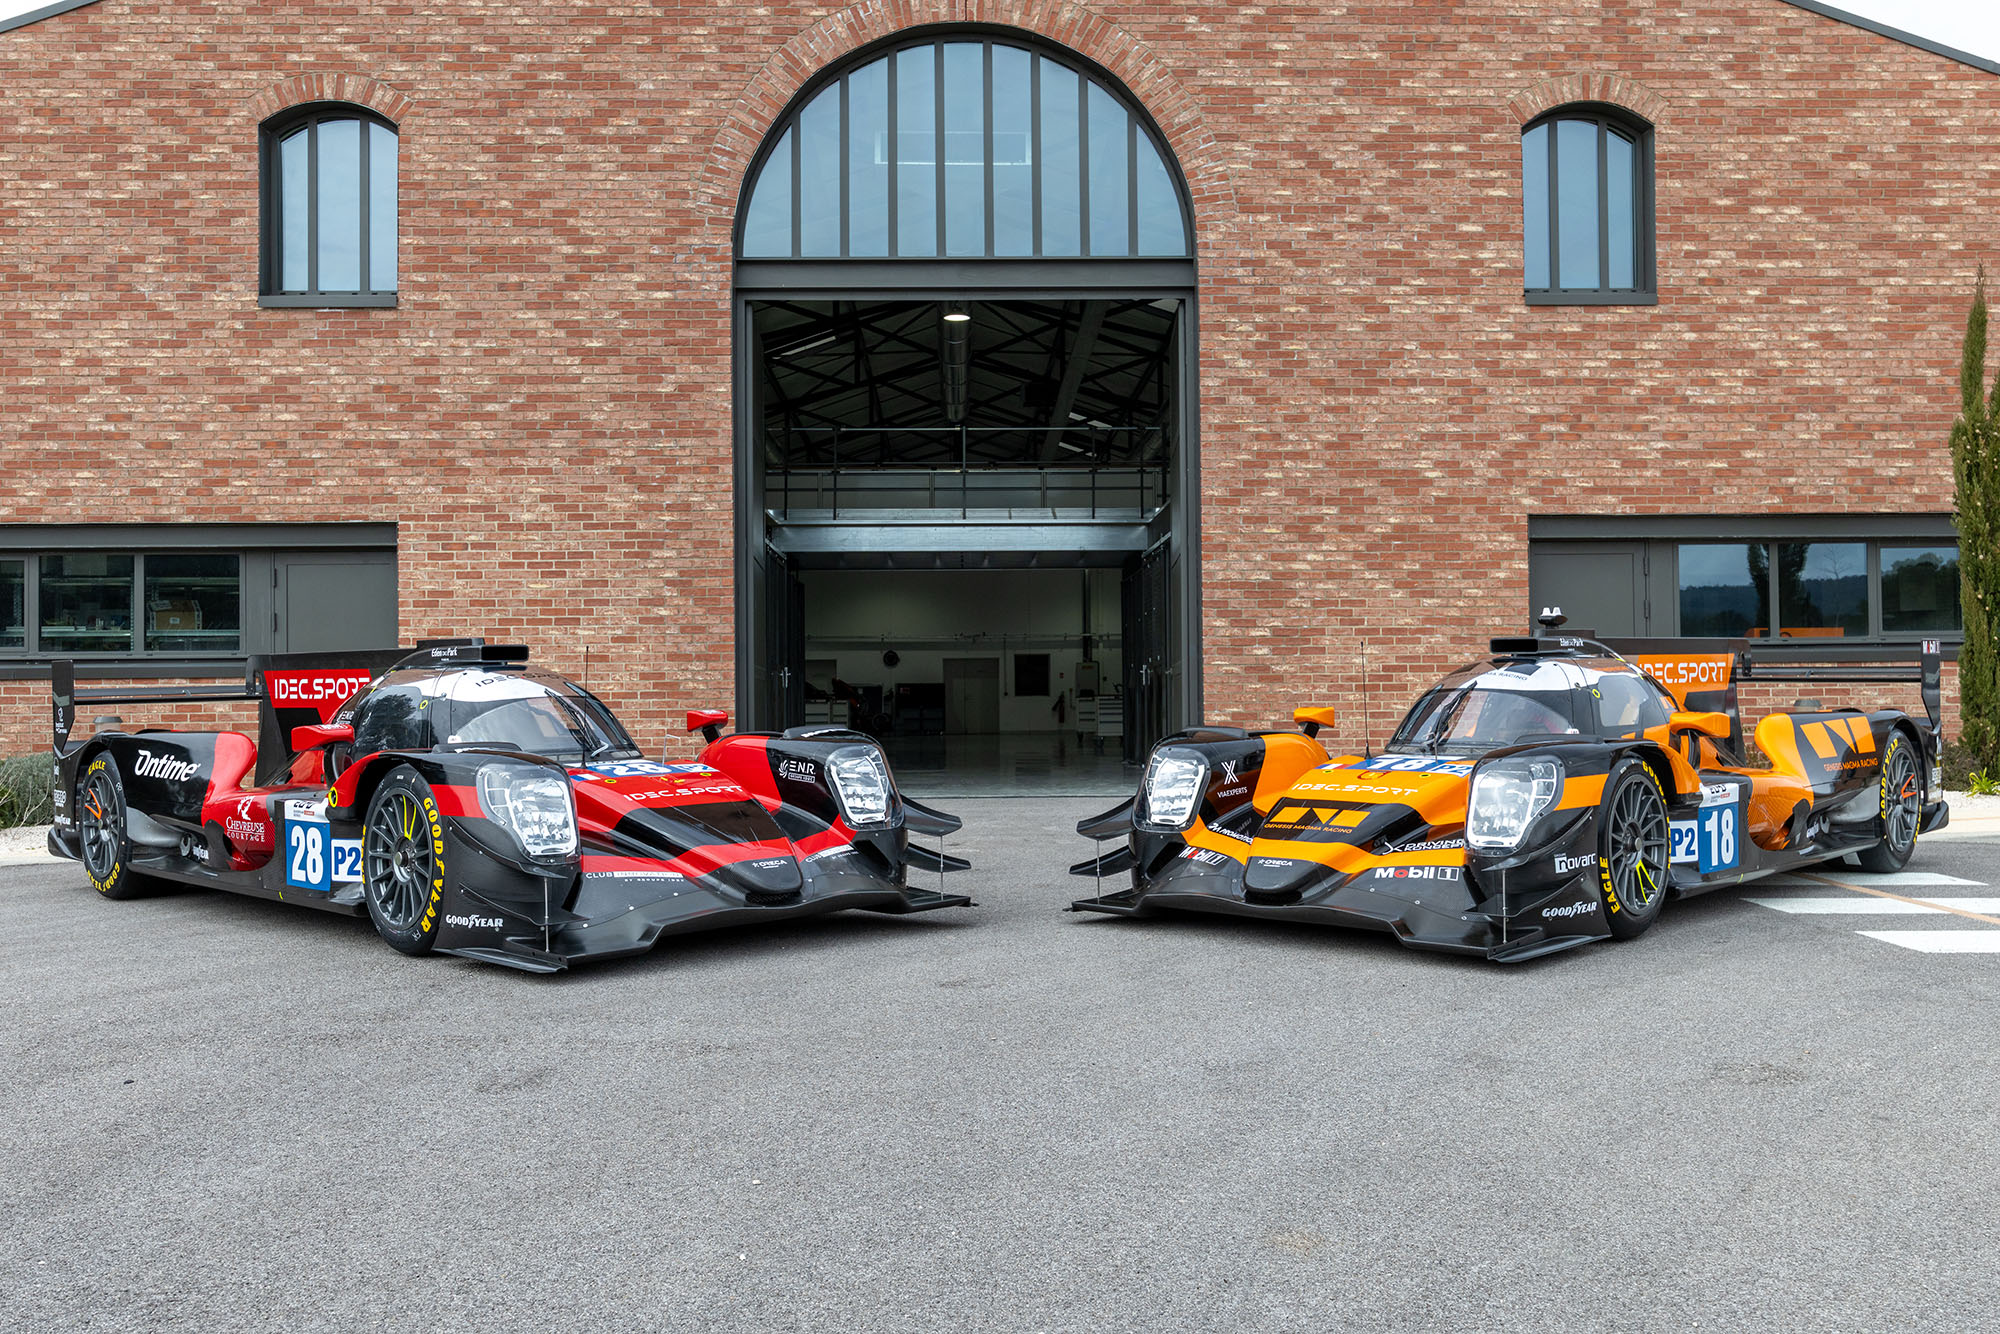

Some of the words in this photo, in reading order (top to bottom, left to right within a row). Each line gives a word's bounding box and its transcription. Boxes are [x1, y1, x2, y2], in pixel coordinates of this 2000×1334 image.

[88, 760, 106, 776] EAGLE
[135, 749, 201, 782] Ontime
[597, 763, 673, 776] 28
[1366, 758, 1430, 771] 18
[1432, 764, 1471, 775] P2
[624, 785, 743, 801] IDEC.SPORT
[1217, 786, 1248, 798] VIAEXPERTS
[1292, 783, 1419, 796] IDEC.SPORT
[226, 831, 265, 842] COURTAGE
[1670, 827, 1696, 857] P2
[1705, 808, 1735, 867] 18
[291, 825, 324, 885] 28
[334, 846, 361, 876] P2
[1178, 846, 1213, 862] Mobil
[421, 797, 445, 933] GOODYEAR
[1263, 859, 1293, 867] ORECA
[585, 871, 613, 879] CLUB
[1374, 867, 1436, 879] Mobil
[1600, 856, 1620, 914] EAGLE
[1541, 901, 1597, 918] GOODYEAR
[445, 914, 503, 929] GOODYEAR
